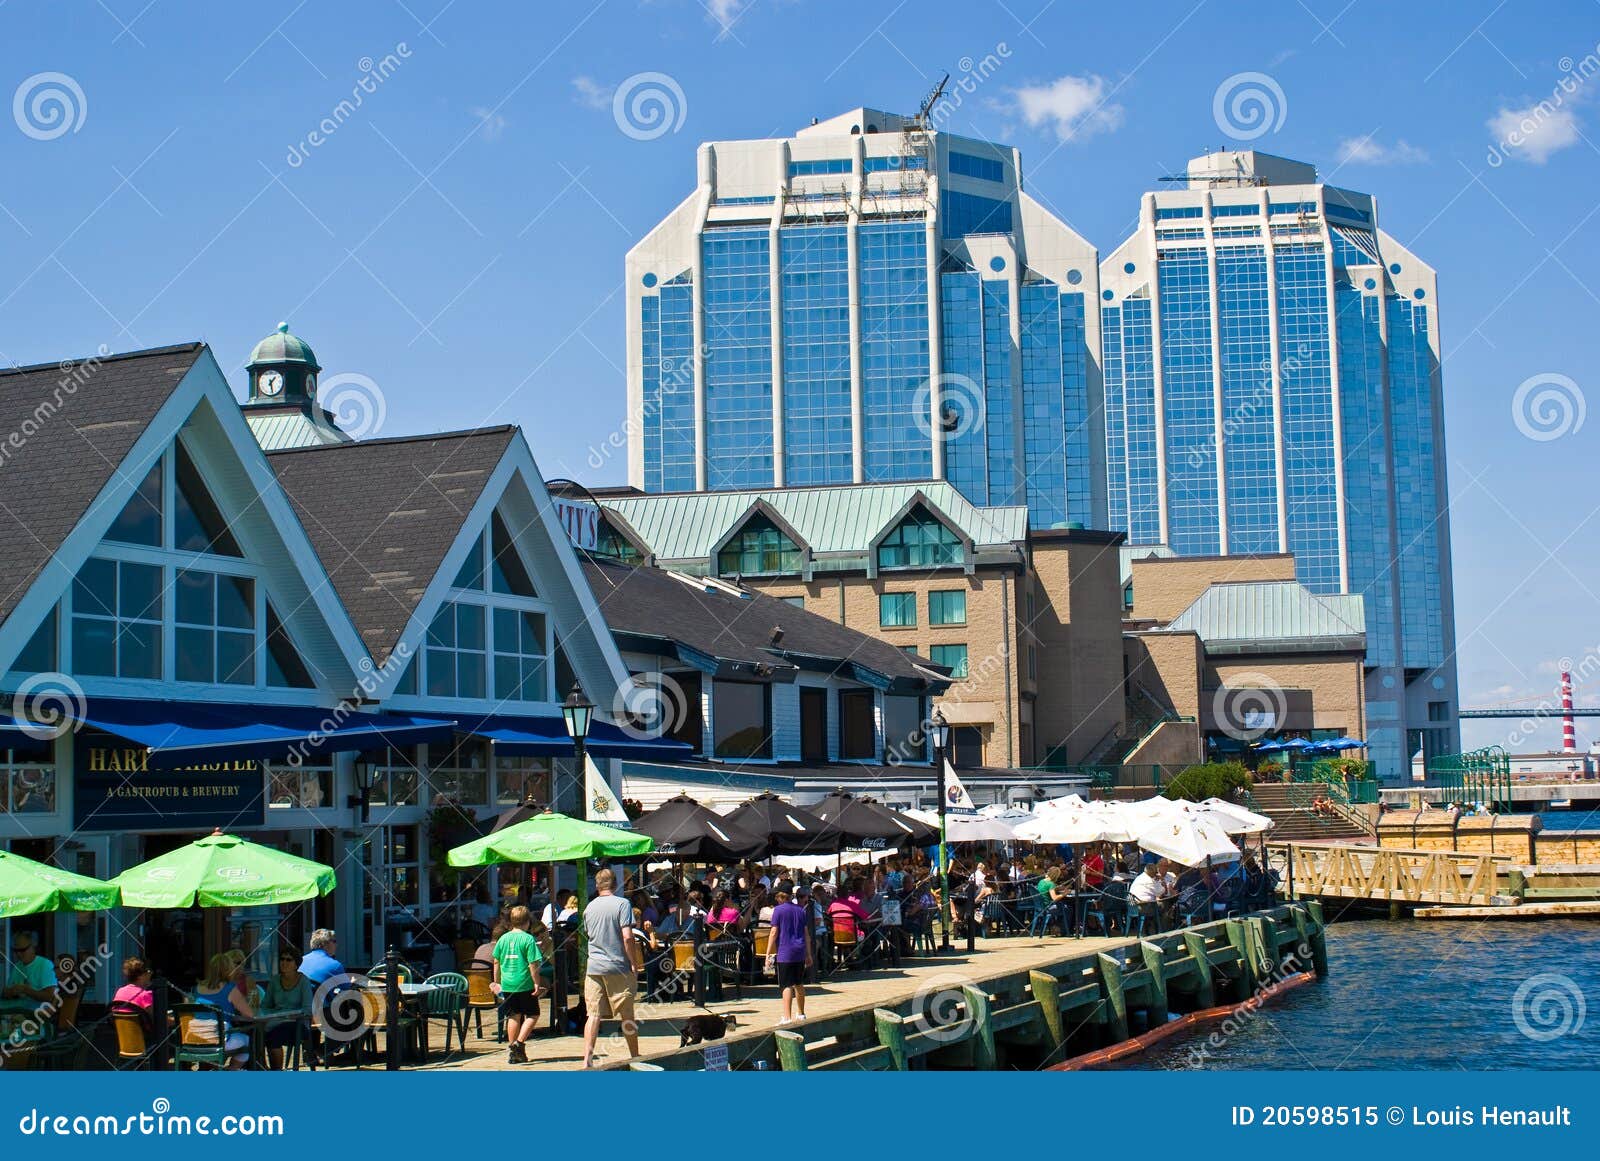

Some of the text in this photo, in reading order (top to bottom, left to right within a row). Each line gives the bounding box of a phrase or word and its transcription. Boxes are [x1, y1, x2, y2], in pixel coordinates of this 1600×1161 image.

[88, 748, 149, 771] HART
[107, 786, 240, 797] A GASTROPUB & BREWERY
